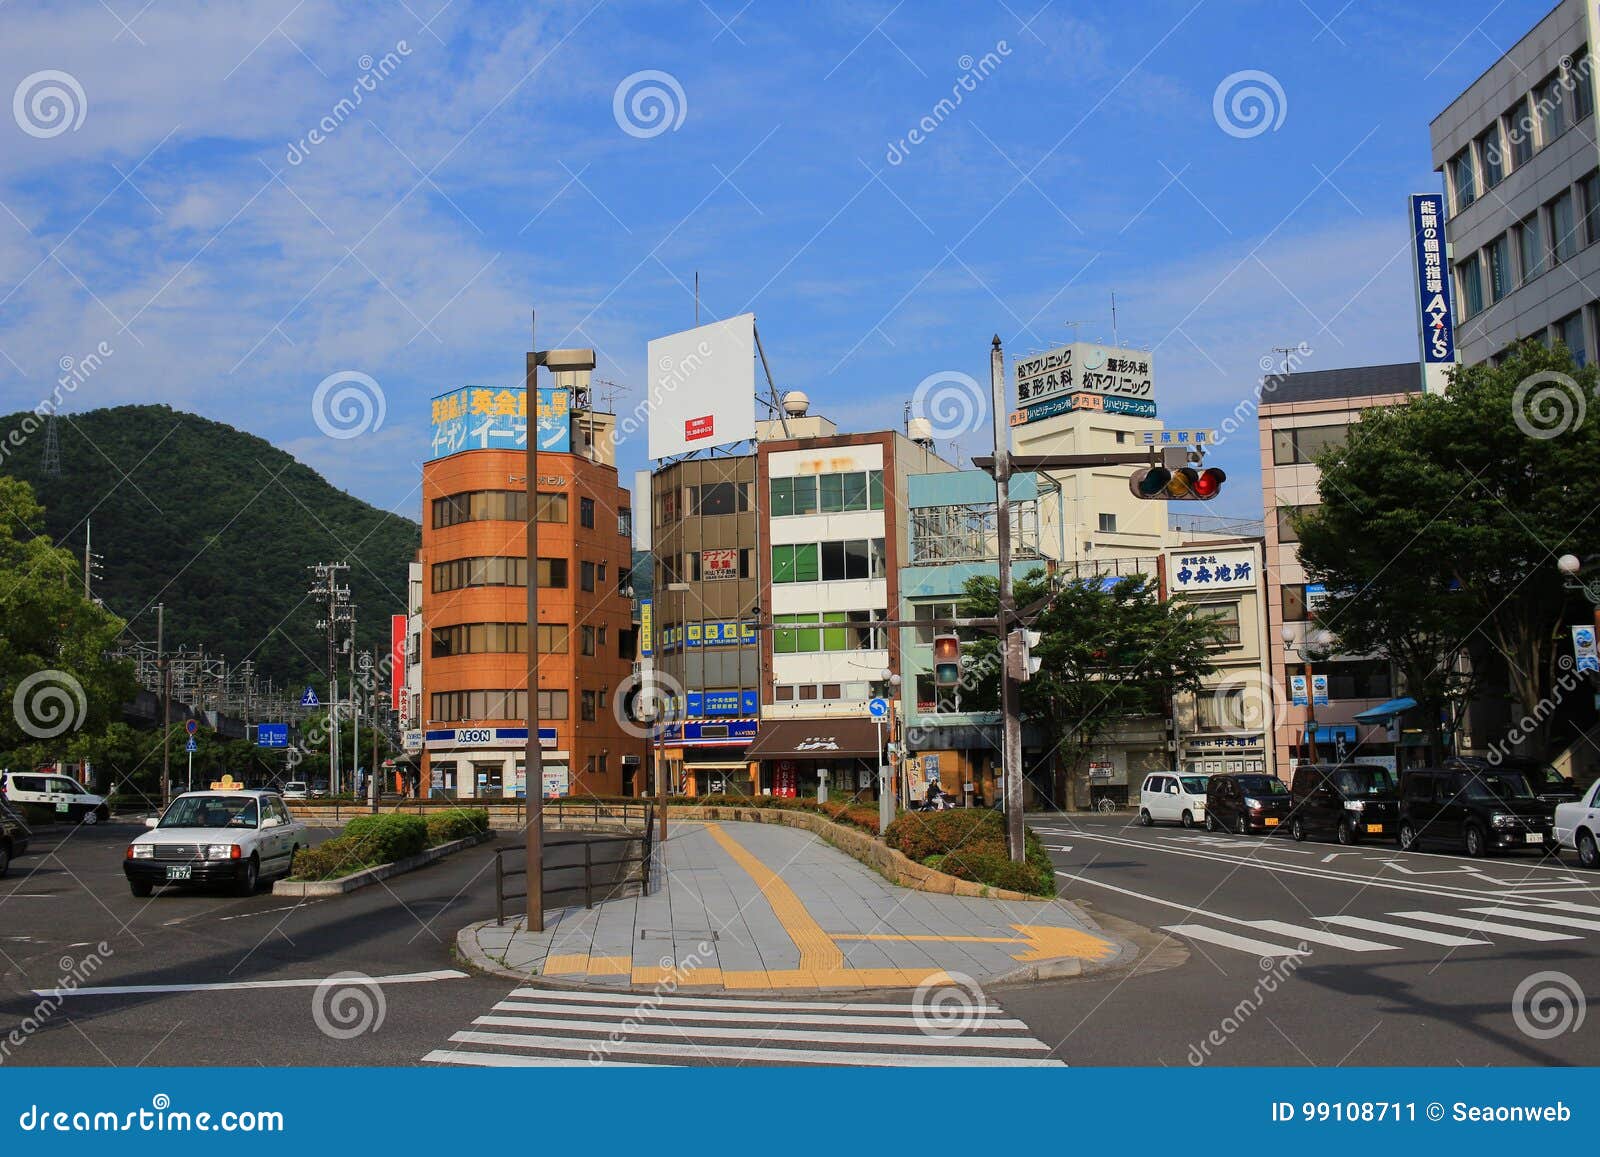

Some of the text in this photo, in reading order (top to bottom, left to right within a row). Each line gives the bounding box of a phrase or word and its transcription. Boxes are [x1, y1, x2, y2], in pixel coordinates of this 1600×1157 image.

[1018, 350, 1072, 378] 松下クリニック
[1107, 358, 1148, 376] 整形外科
[1018, 368, 1073, 400] 整形外科
[1082, 371, 1151, 396] 松下クリニック
[1143, 432, 1206, 444] 三原駅前
[703, 551, 736, 561] テナント
[1177, 562, 1252, 585] 中央地所
[459, 730, 490, 742] AEON
